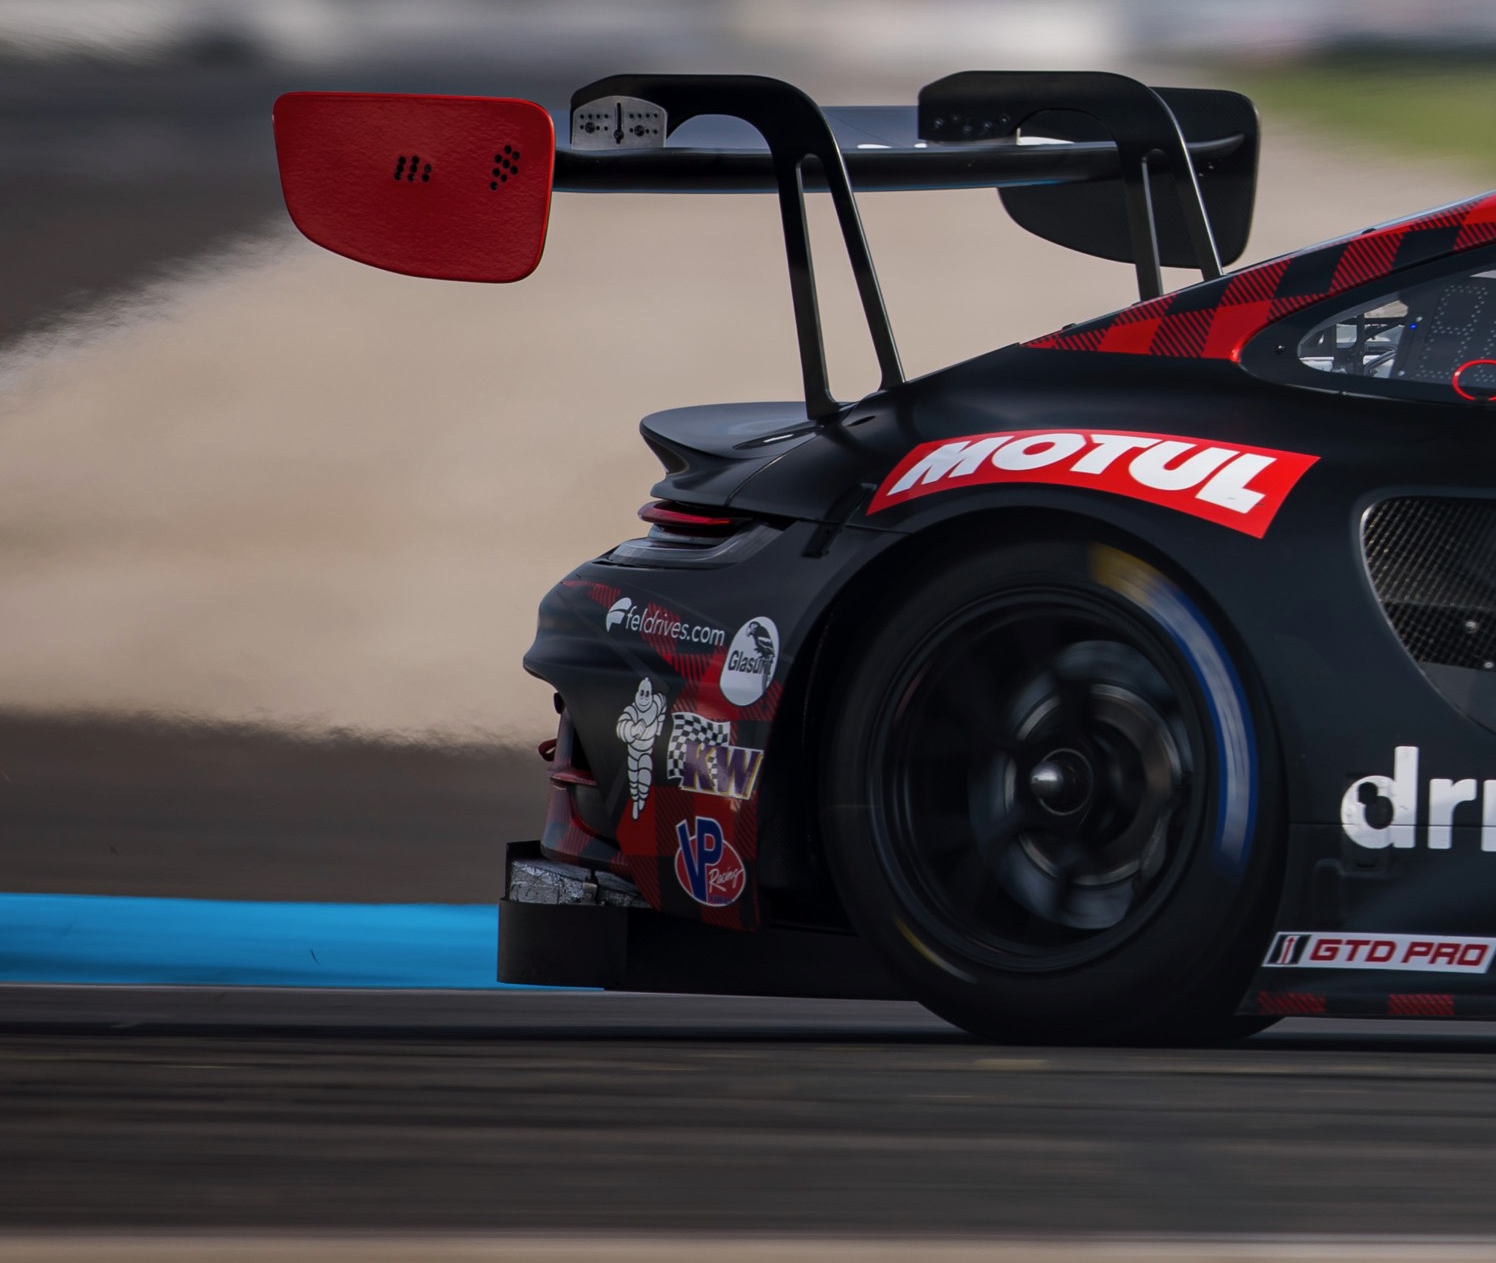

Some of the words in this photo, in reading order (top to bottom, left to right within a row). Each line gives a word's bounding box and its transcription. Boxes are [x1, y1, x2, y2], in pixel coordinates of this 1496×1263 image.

[888, 431, 1276, 515] MOTUL
[625, 605, 726, 647] feldrives.com
[681, 740, 764, 800] KW
[675, 815, 724, 905] VP
[1309, 938, 1398, 963] GTD
[1401, 941, 1490, 967] PRO
